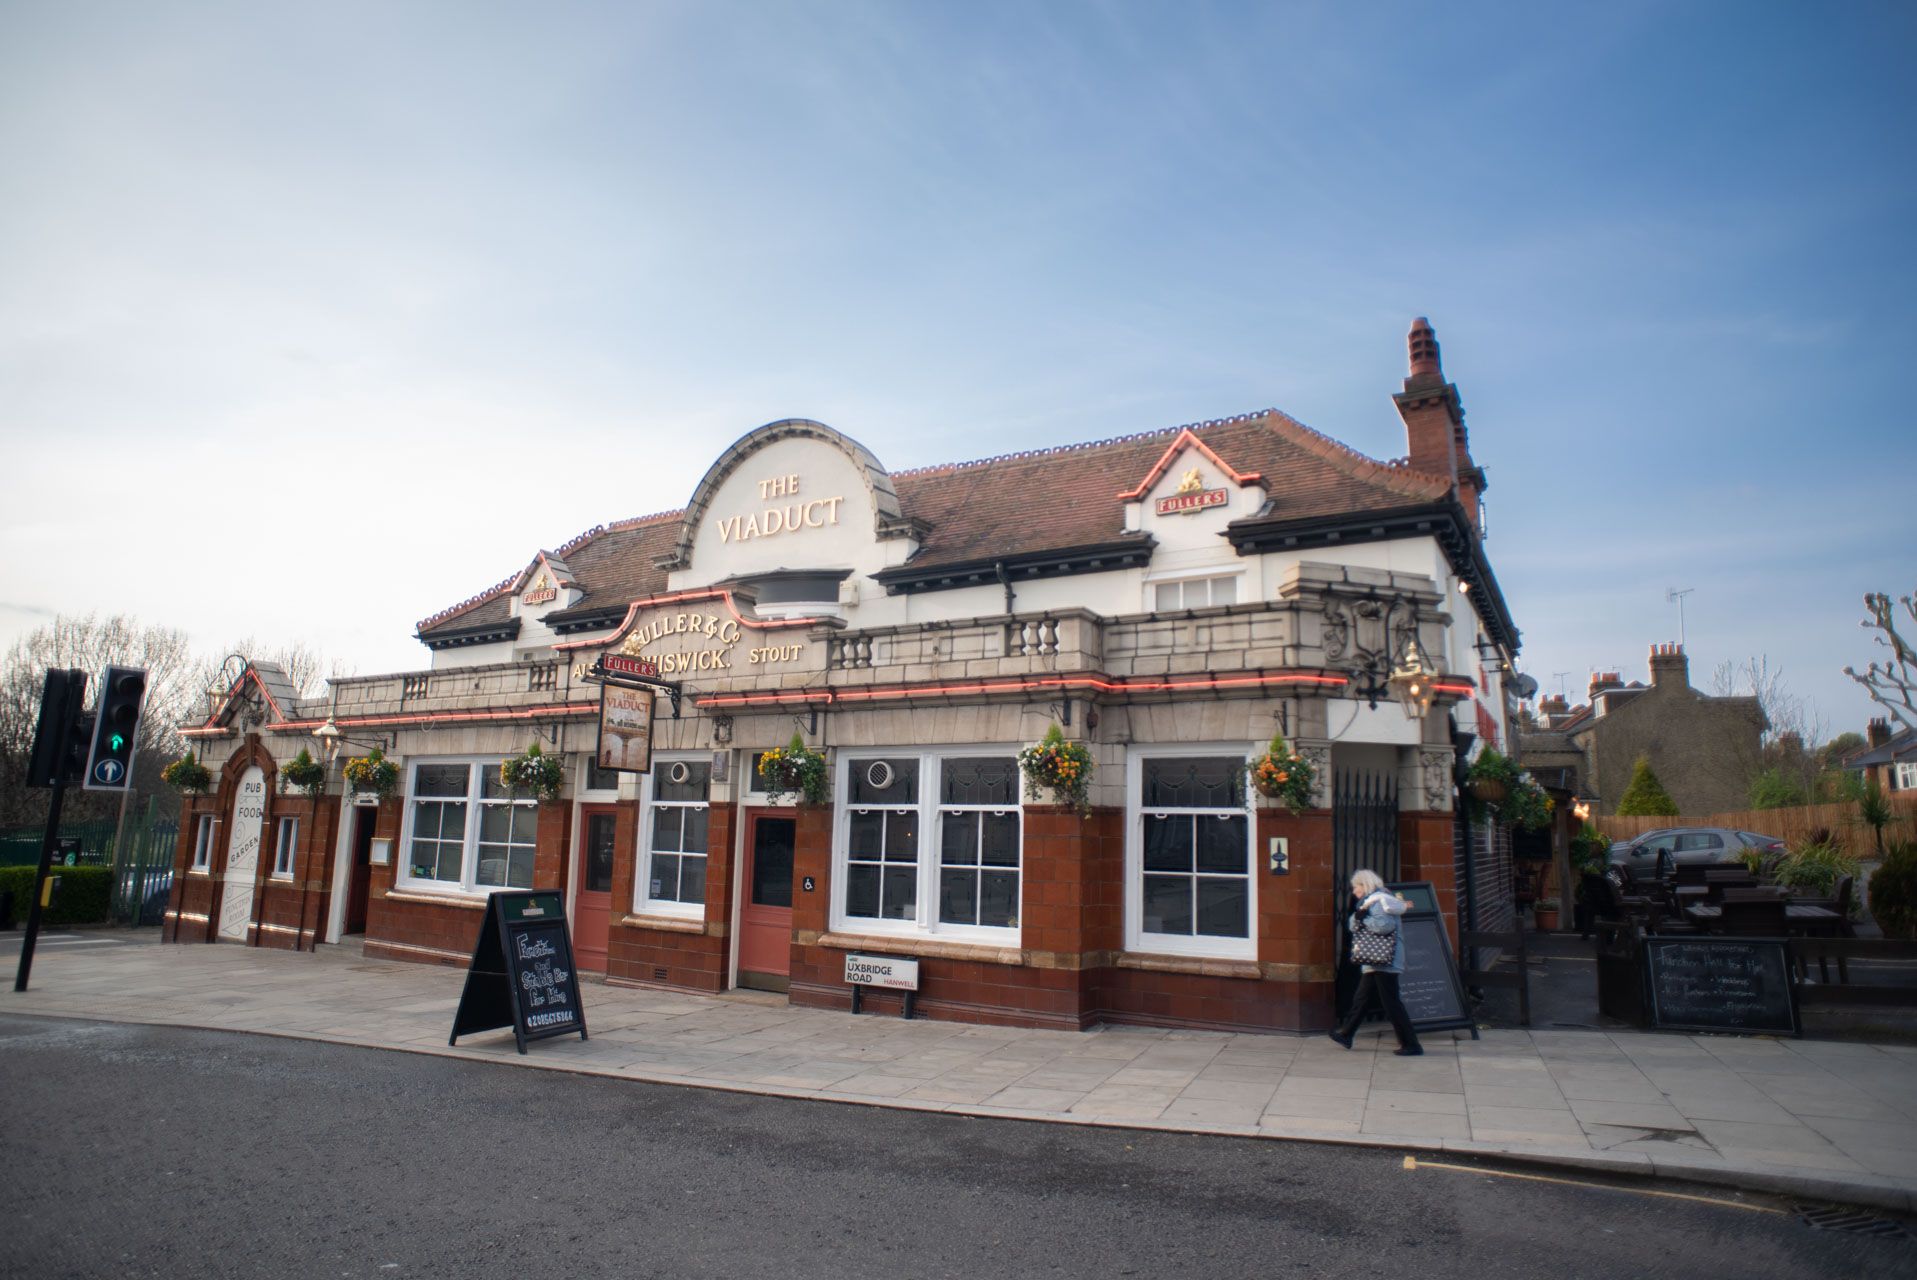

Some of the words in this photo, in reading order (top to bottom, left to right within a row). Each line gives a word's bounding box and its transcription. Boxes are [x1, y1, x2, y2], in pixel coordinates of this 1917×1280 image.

[758, 474, 800, 500] THE
[717, 496, 845, 544] VIADUCT
[639, 613, 703, 646] ULLER
[749, 645, 803, 665] STOUT
[622, 691, 637, 701] THE
[605, 697, 650, 713] VIADUCT
[245, 782, 261, 794] PUB
[238, 808, 262, 819] FOOD
[230, 837, 260, 863] GARDEN
[847, 962, 892, 976] UXBRIDGE
[847, 972, 873, 983] ROAD
[884, 979, 915, 988] HANWELL
